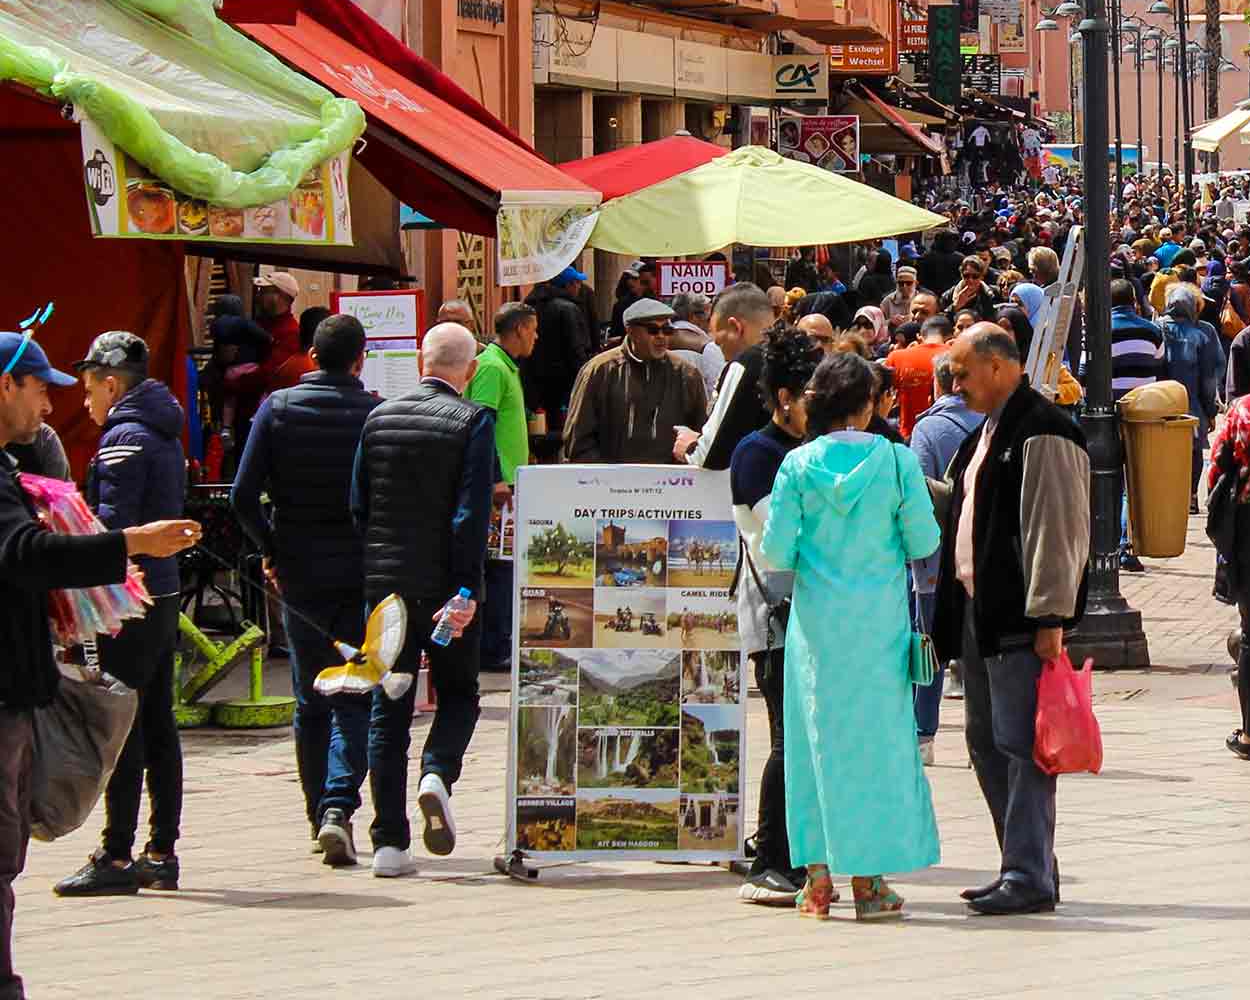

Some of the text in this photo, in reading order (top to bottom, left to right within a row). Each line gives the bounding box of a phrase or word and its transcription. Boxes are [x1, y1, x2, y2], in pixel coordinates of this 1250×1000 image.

[848, 45, 884, 56] Exchange
[849, 57, 885, 65] Wechsel
[671, 264, 713, 277] NAIM
[671, 281, 715, 294] FOOD
[573, 508, 597, 518] DAY
